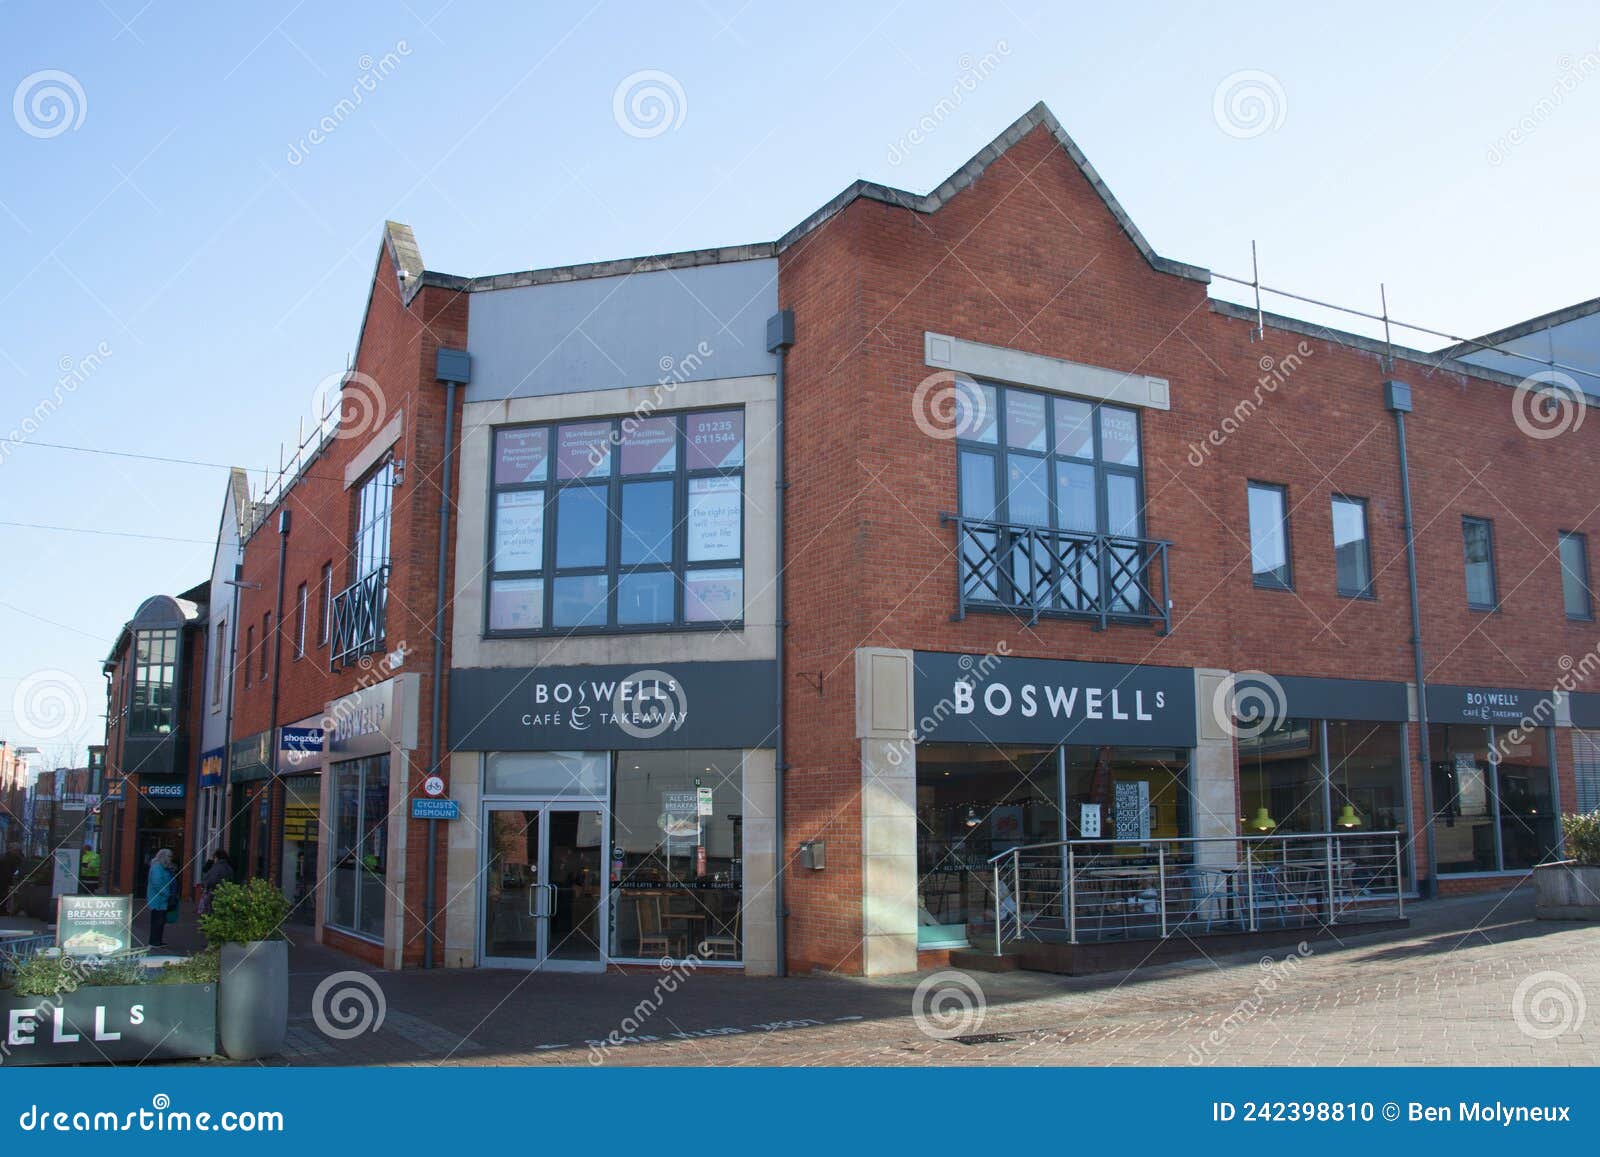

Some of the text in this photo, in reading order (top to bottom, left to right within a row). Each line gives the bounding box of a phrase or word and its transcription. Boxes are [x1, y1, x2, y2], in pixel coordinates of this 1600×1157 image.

[698, 421, 733, 433] 01235
[694, 432, 736, 444] 811544
[521, 710, 562, 726] CAFÉ
[599, 711, 689, 724] TAKEAWAY
[148, 785, 182, 796] GREGGS
[417, 800, 453, 809] CYCLISTS
[414, 808, 456, 817] DISMOUNT
[1116, 822, 1139, 832] SOUP
[74, 900, 117, 909] ALL DAY
[66, 909, 123, 918] BREAKFAST
